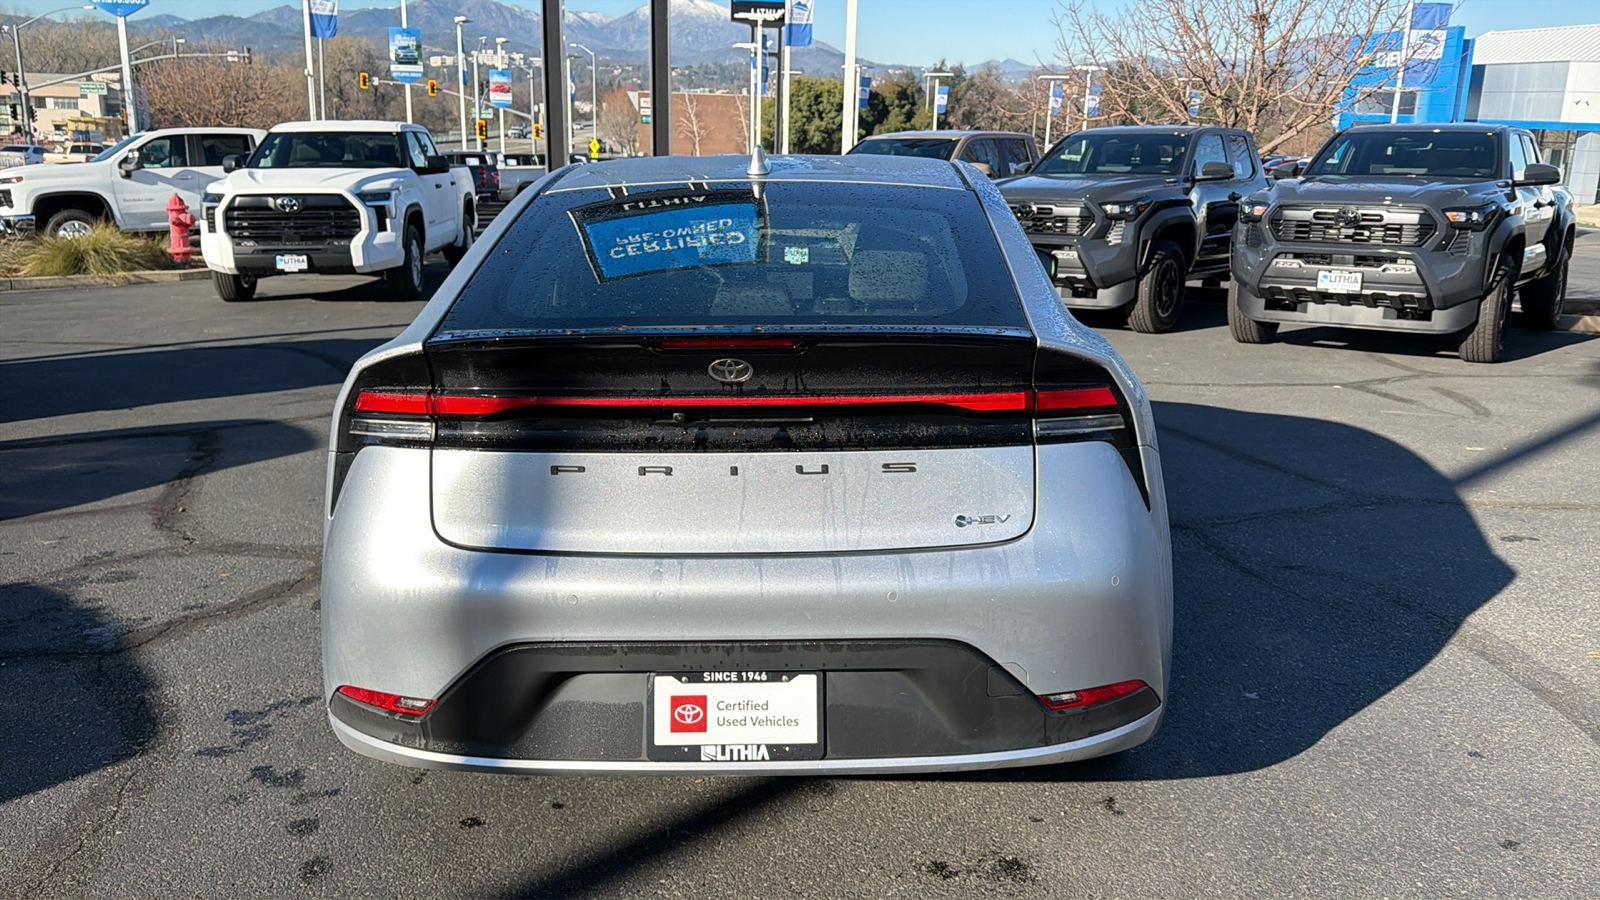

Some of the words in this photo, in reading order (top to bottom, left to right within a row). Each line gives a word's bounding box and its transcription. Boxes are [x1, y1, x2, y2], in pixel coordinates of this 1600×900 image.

[1329, 274, 1360, 285] LITHIA
[550, 462, 917, 476] PRIUS
[703, 672, 738, 682] SINCE
[741, 671, 768, 681] 1946
[716, 700, 769, 711] Certified
[716, 716, 747, 727] Used
[750, 716, 799, 727] Vehicles
[716, 744, 770, 760] LITHIA
